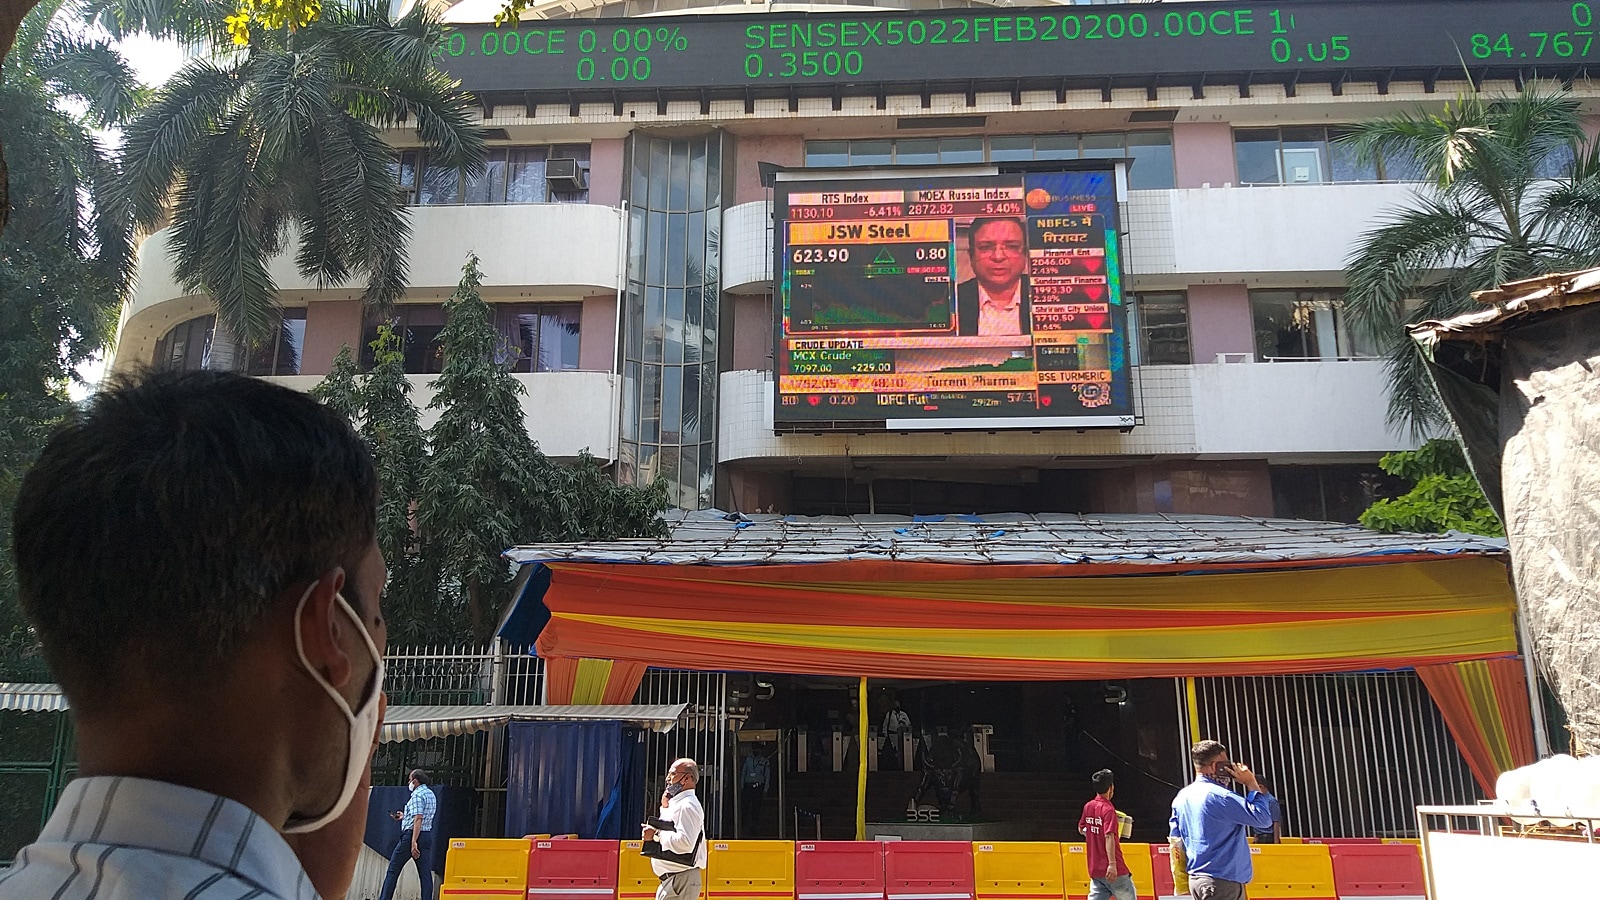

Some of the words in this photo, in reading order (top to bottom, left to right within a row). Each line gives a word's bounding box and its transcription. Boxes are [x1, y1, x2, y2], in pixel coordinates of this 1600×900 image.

[744, 9, 1254, 50] SENSEX5022FEB20200.00CE
[578, 26, 688, 54] 0.00%
[576, 55, 652, 82] 0.00
[744, 51, 864, 79] 0.3500
[821, 193, 840, 204] RTS
[843, 193, 869, 203] Index
[918, 190, 945, 201] MOEX
[948, 190, 981, 201] Russia
[983, 189, 1011, 200] Index
[790, 208, 834, 219] 1130.10
[863, 206, 902, 217] -6.41%
[908, 204, 954, 215] 2872.82
[981, 203, 1021, 214] -5.40%
[1072, 203, 1095, 212] LIVE
[1036, 218, 1078, 228] NBFCs
[827, 224, 863, 240] JSW
[867, 223, 911, 239] Steel
[1042, 231, 1089, 244] गिरावट
[793, 248, 850, 263] 623.90
[915, 247, 948, 260] 0.80
[1032, 258, 1072, 266] 2046.00
[1033, 276, 1072, 284] Sundaram
[1074, 276, 1103, 284] Finance
[1033, 286, 1073, 294] 1993.30
[1035, 305, 1065, 313] Shriram
[1083, 304, 1105, 312] Union
[795, 340, 825, 350] CRUDE
[828, 339, 864, 349] UPDATE
[793, 351, 816, 361] MCX
[820, 350, 852, 360] Crude
[794, 363, 833, 373] 7097.00
[851, 362, 891, 373] +229.00
[1038, 372, 1057, 382] BSE
[1059, 371, 1106, 382] TURMERIC
[906, 809, 940, 822] BSE
